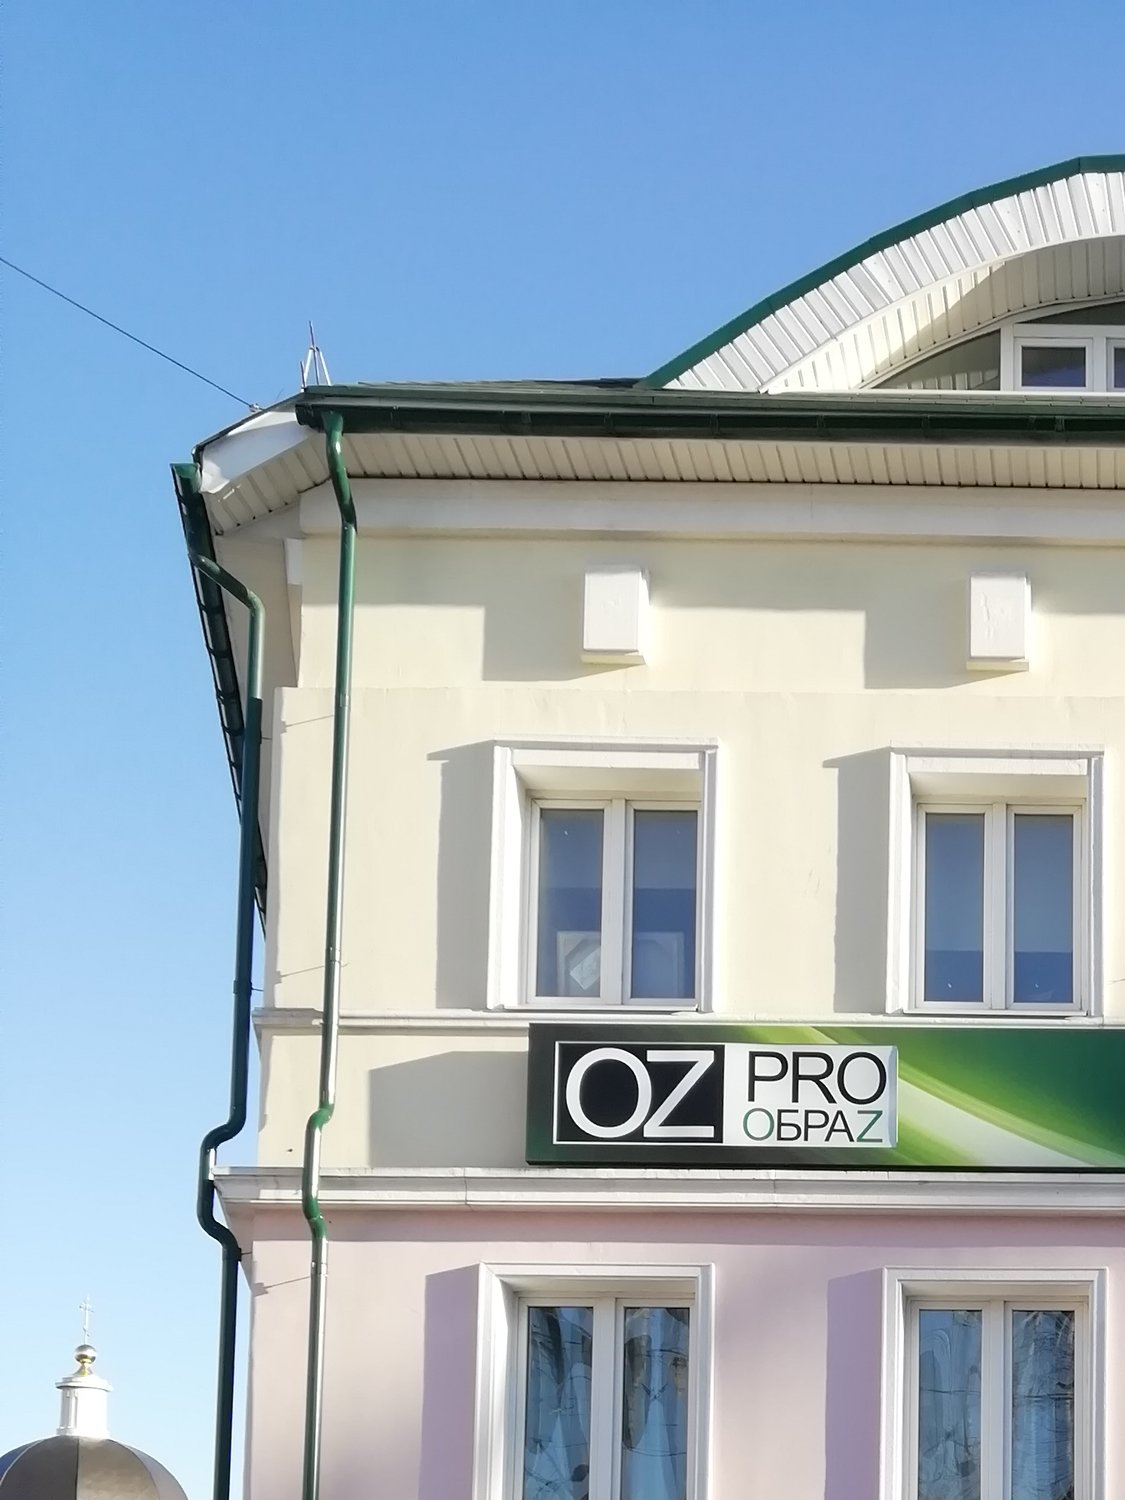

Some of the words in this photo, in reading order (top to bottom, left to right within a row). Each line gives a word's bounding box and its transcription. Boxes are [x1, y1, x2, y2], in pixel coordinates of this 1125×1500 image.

[565, 1047, 715, 1139] OZ
[747, 1050, 887, 1105] PRO
[743, 1107, 883, 1143] ОБРАZ
